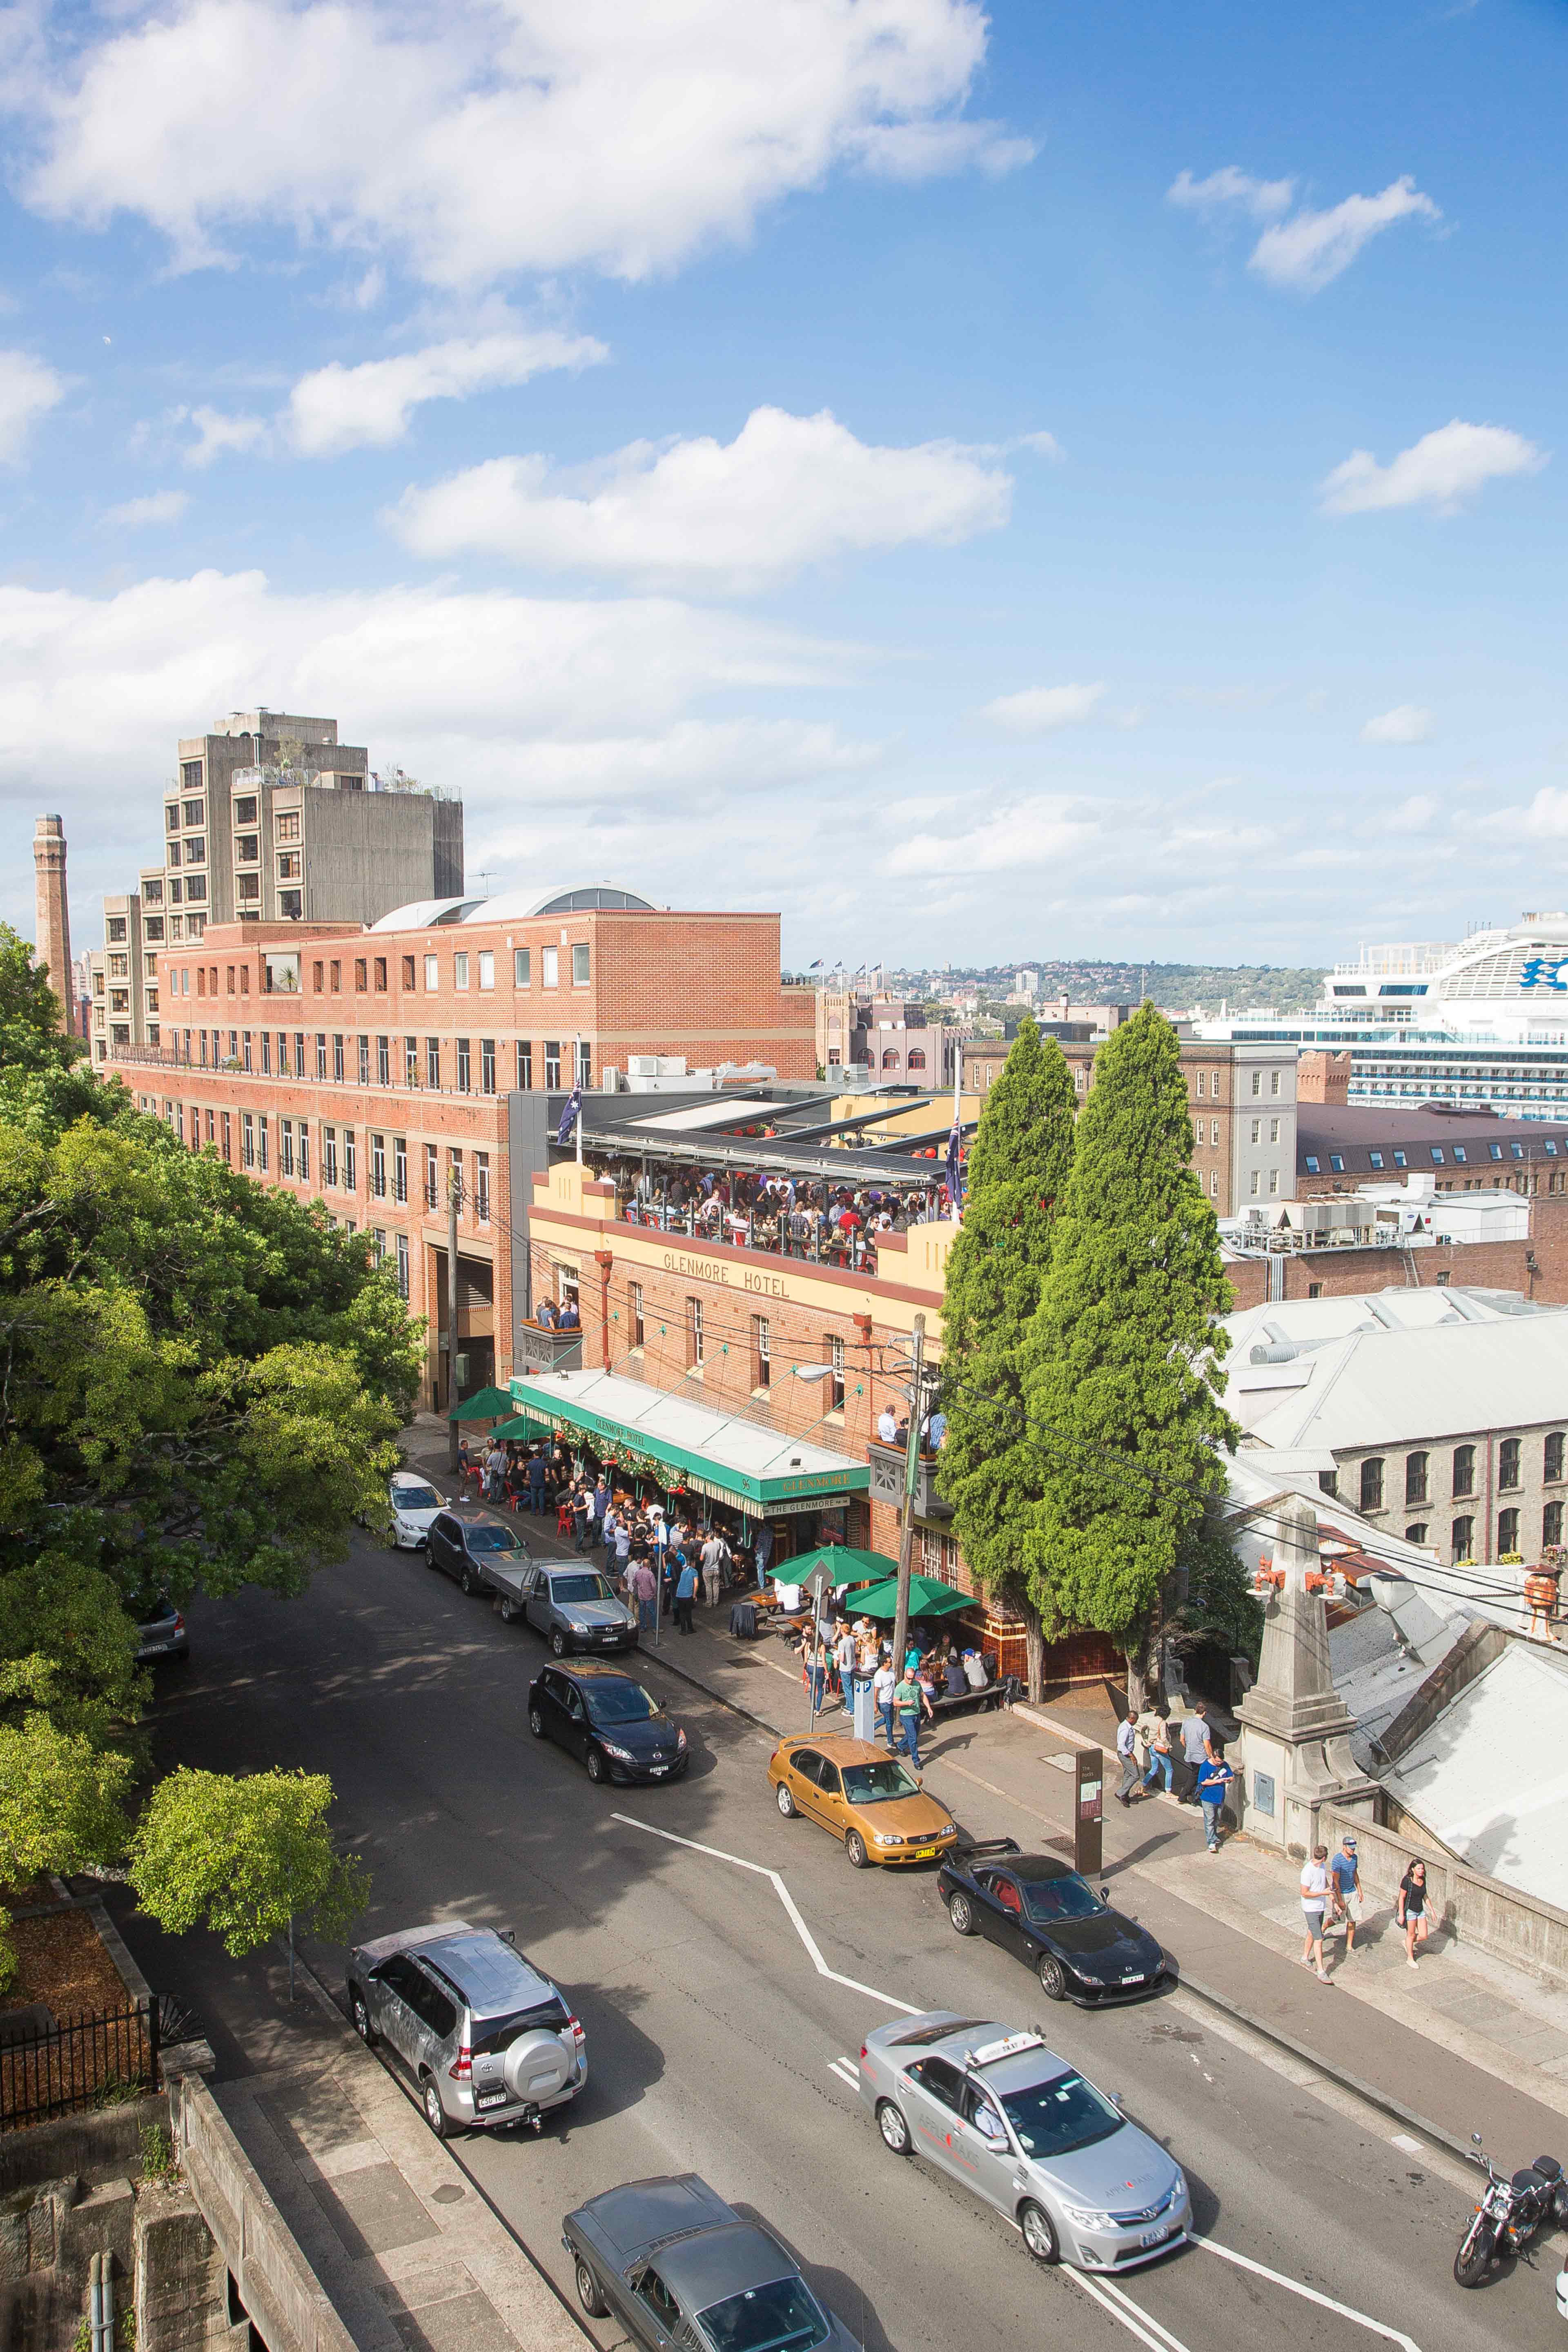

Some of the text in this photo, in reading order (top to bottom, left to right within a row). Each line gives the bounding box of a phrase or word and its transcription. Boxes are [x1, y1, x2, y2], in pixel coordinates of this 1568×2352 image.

[664, 1254, 789, 1298] GLENMORE HOTEL
[517, 1385, 523, 1395] 96
[595, 1418, 645, 1446] GLENMORE HOTEL
[742, 1478, 750, 1490] 96
[783, 1473, 850, 1491] GLENMORE
[790, 1499, 834, 1511] GLENMORE
